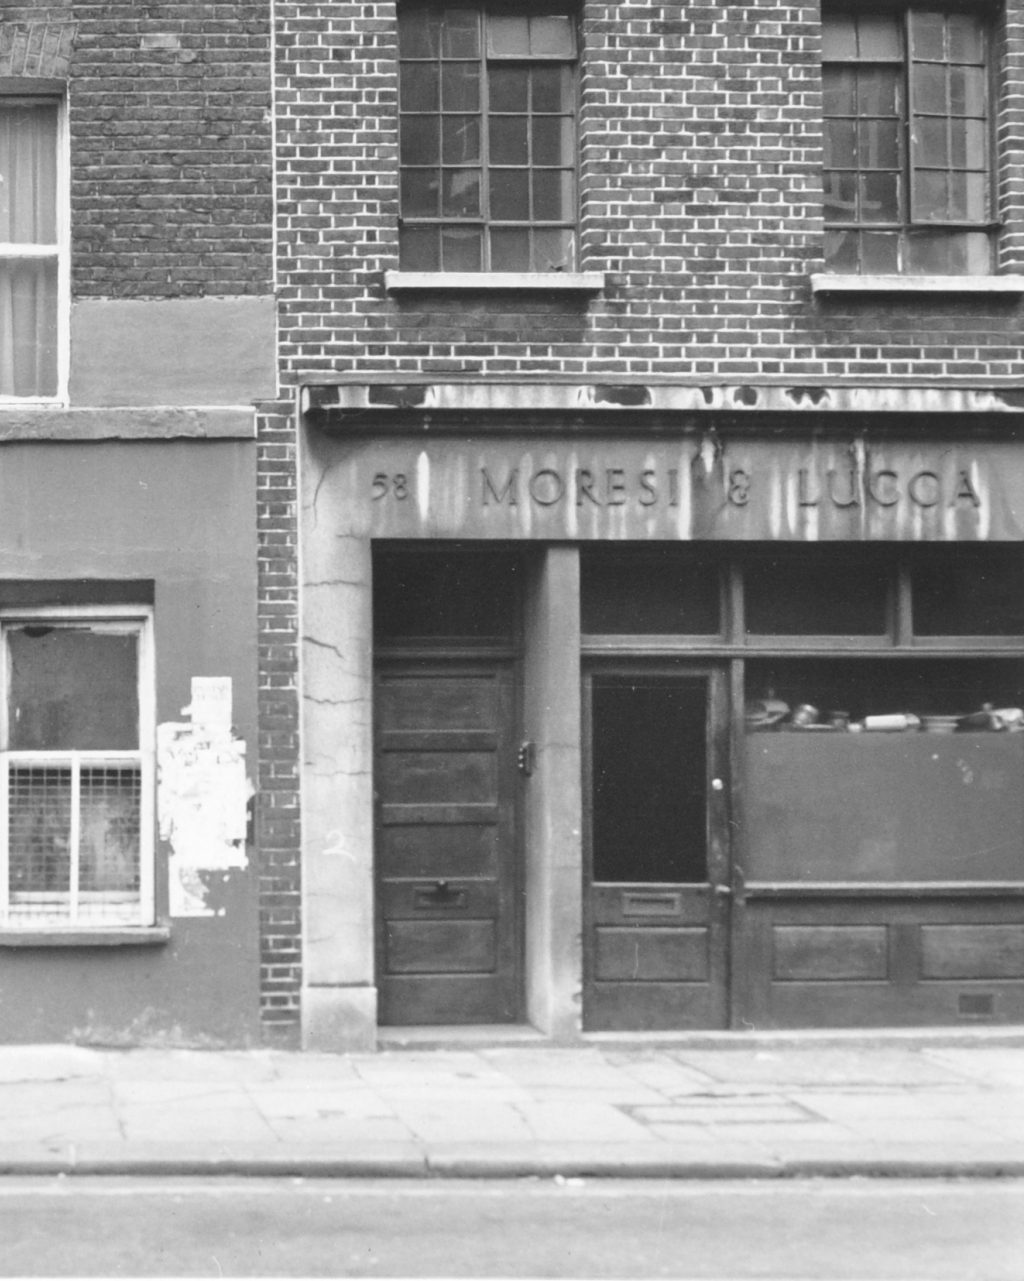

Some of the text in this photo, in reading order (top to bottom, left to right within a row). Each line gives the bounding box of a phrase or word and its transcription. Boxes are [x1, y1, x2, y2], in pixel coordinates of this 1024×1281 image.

[371, 473, 408, 501] 58
[480, 468, 982, 508] MORESI & LUCCA
